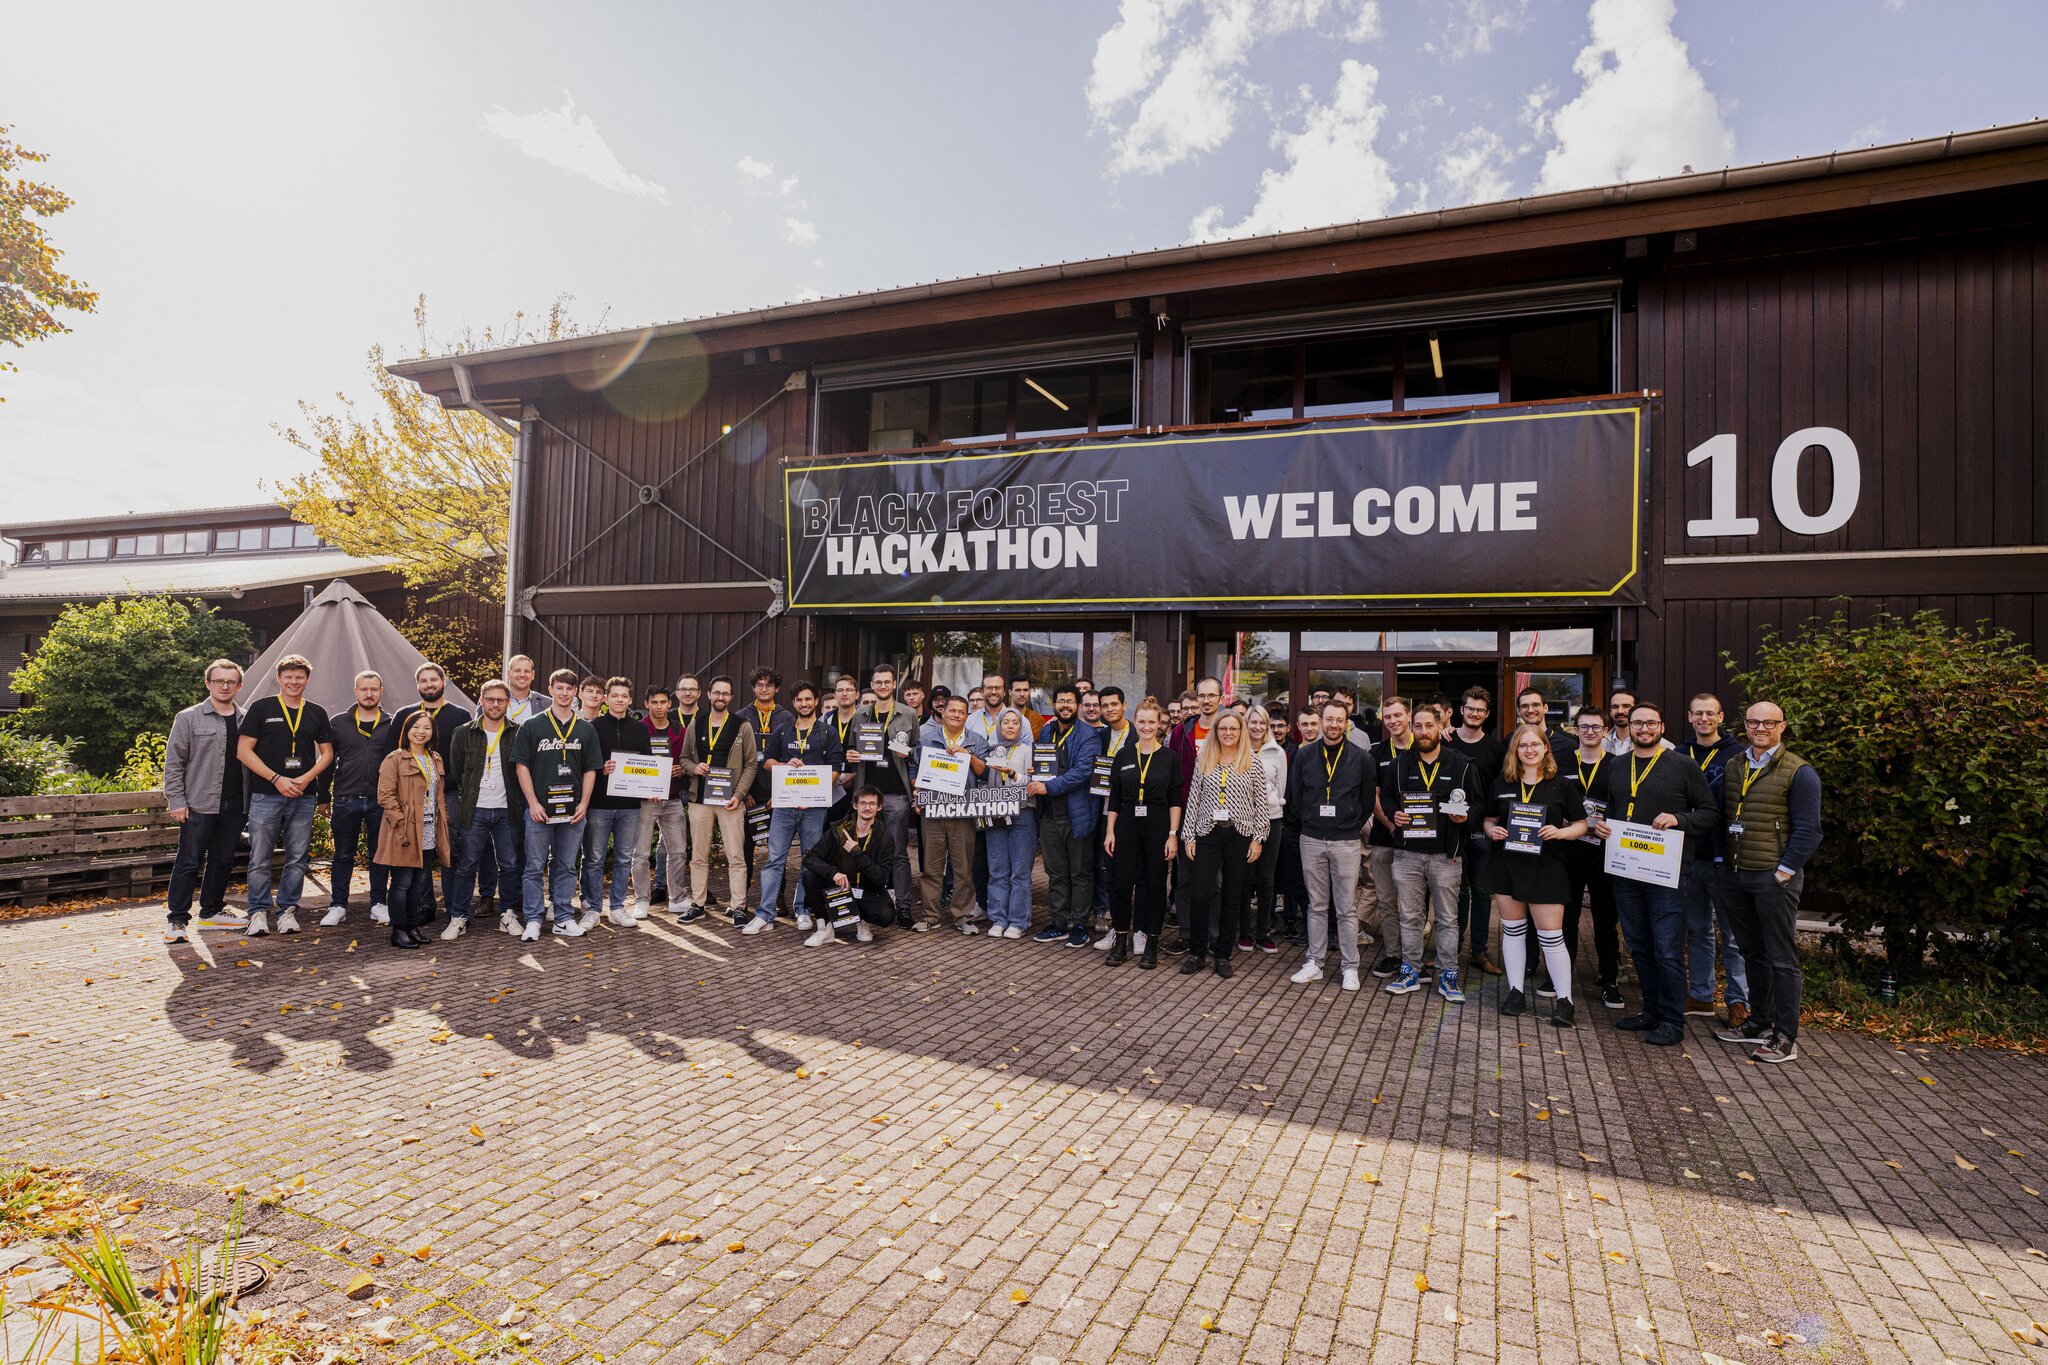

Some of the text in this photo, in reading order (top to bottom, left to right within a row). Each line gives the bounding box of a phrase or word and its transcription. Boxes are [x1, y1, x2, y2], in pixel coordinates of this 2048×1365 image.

[802, 479, 1129, 537] BLACK FOREST
[1687, 426, 1861, 537] 10
[1223, 481, 1538, 540] WELCOME
[826, 524, 1098, 575] HACKATHON
[917, 787, 1028, 805] BLACK FOREST
[925, 801, 1020, 818] HACKATHON
